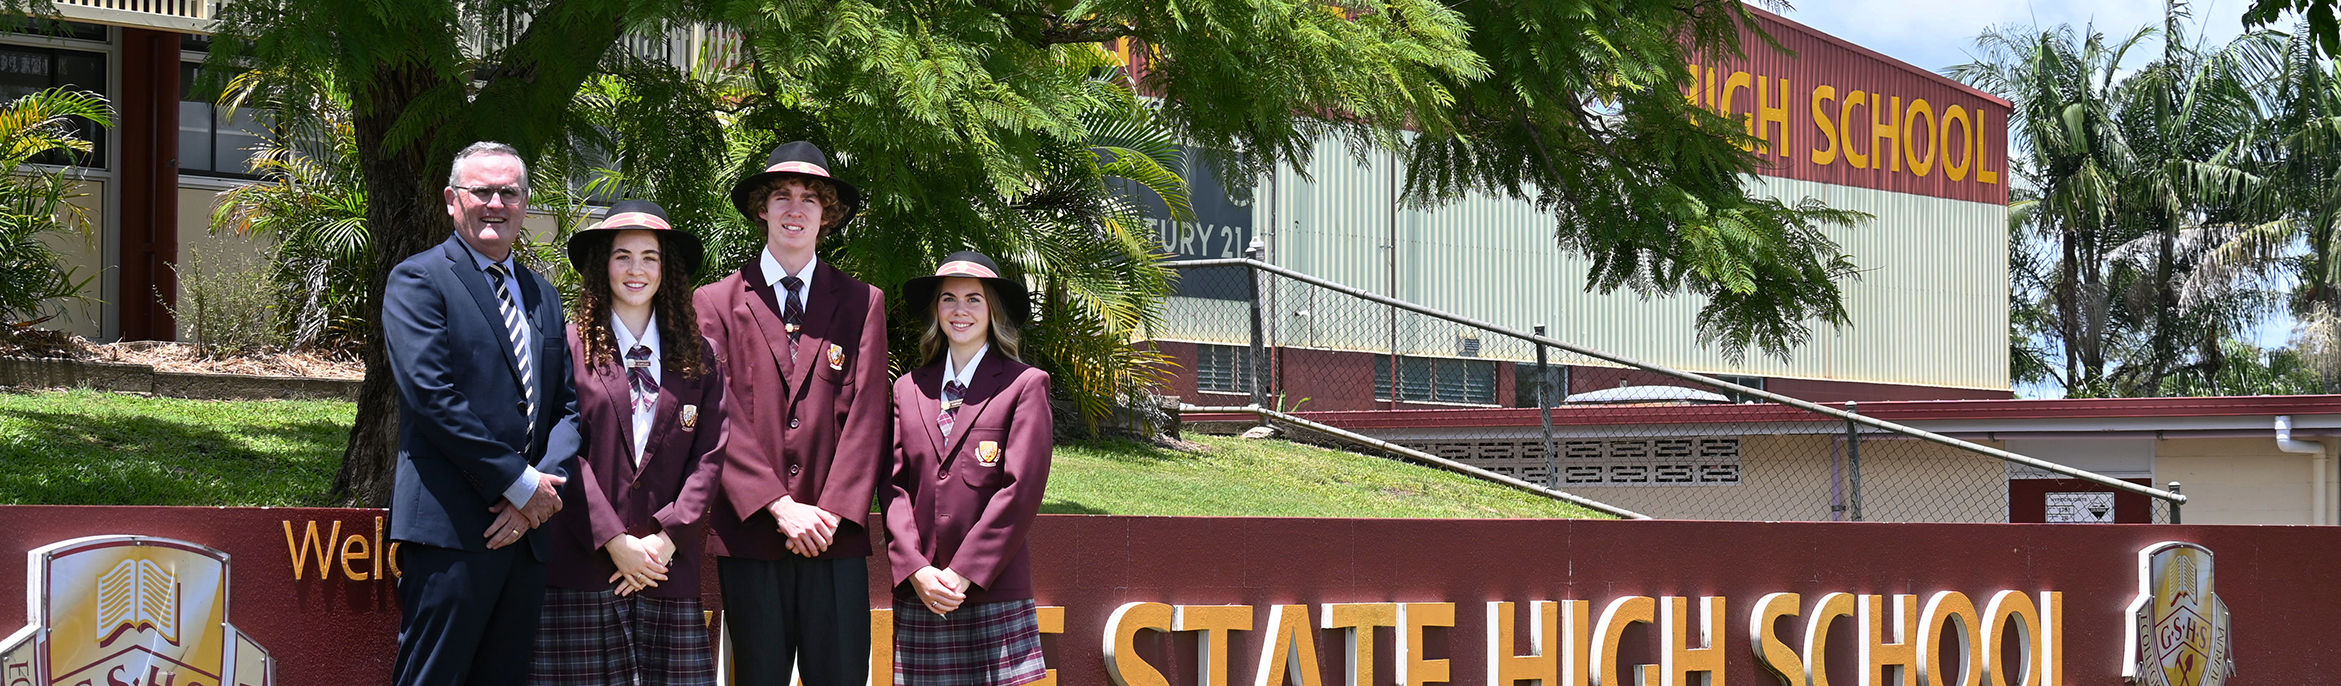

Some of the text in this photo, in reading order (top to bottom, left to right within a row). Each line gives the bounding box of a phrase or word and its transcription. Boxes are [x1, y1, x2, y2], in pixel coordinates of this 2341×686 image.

[1811, 85, 1998, 185] SCHOOL
[1143, 217, 1241, 259] TURY 21
[283, 516, 402, 581] Welc
[1103, 602, 1455, 686] STATE
[1487, 596, 1726, 686] HIGH
